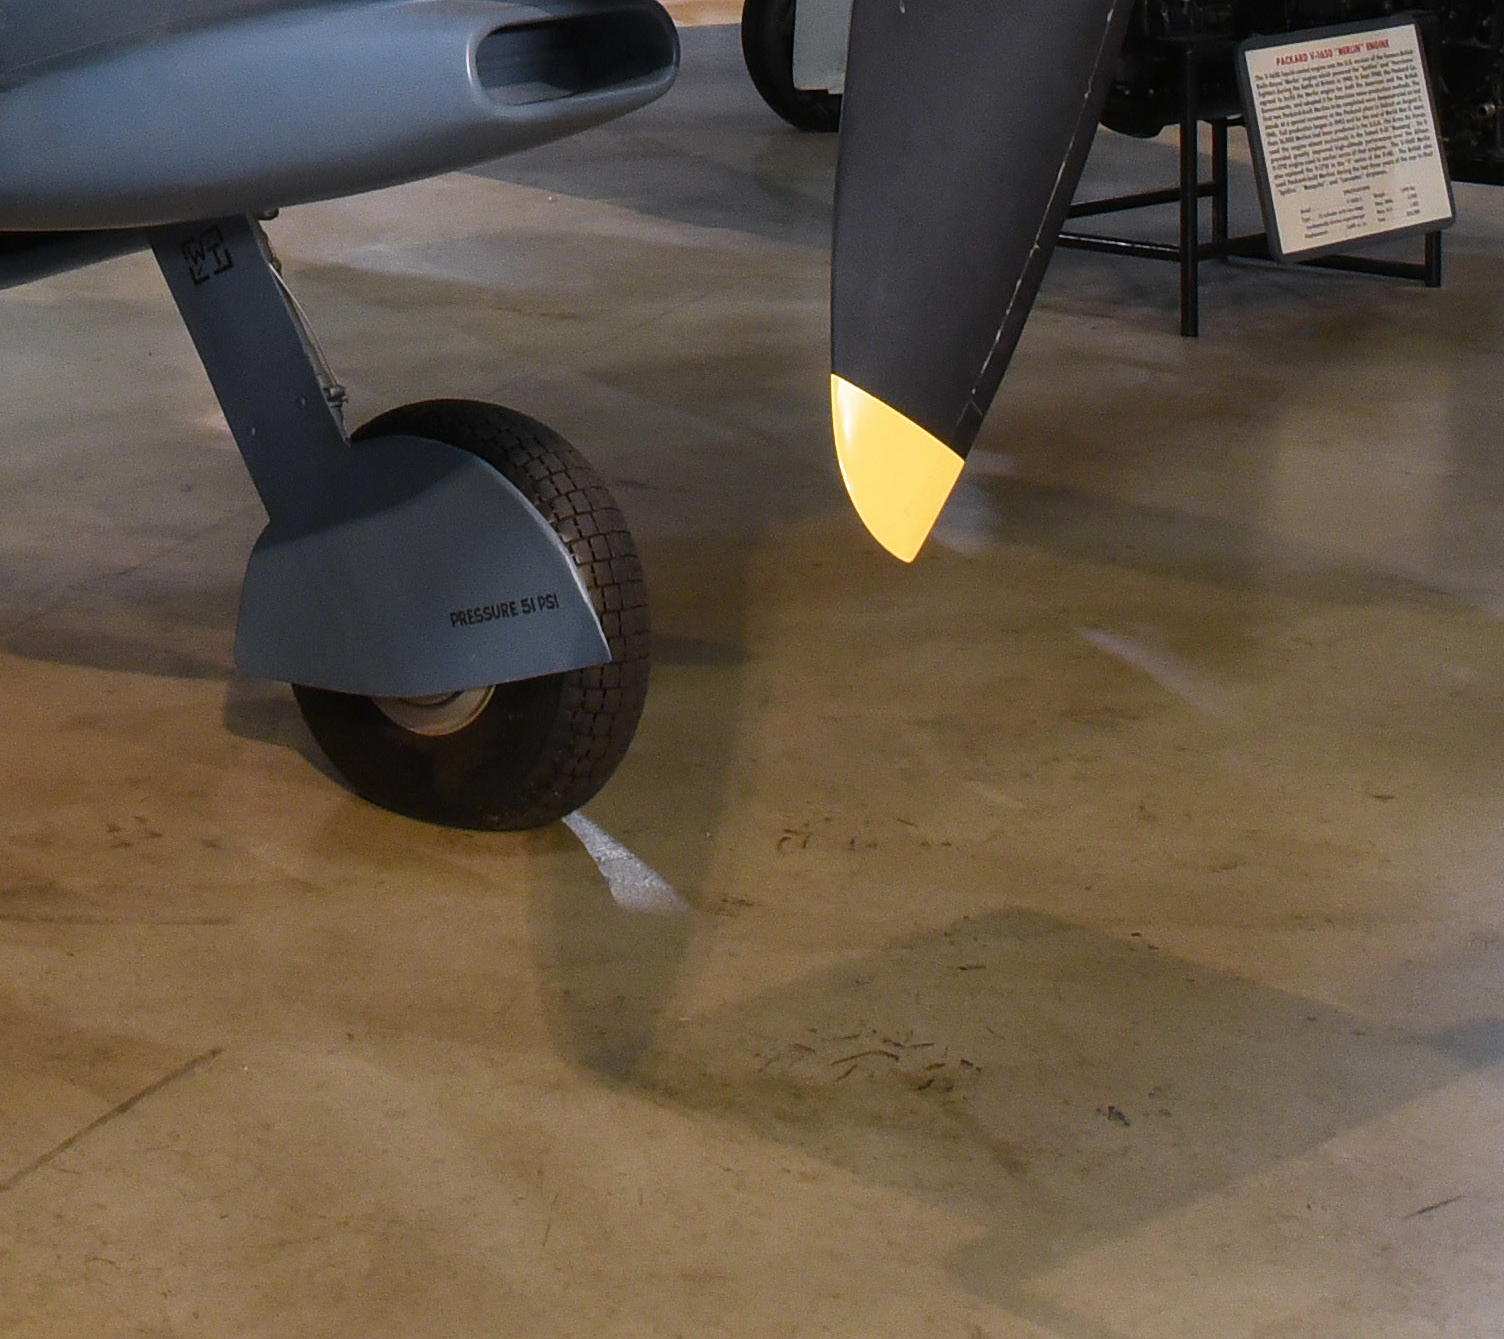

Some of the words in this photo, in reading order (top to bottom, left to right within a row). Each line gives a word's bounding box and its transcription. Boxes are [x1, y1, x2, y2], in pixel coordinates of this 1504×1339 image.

[1275, 52, 1308, 66] PACKARD
[450, 601, 520, 627] PRESSURE
[539, 593, 560, 610] PSI
